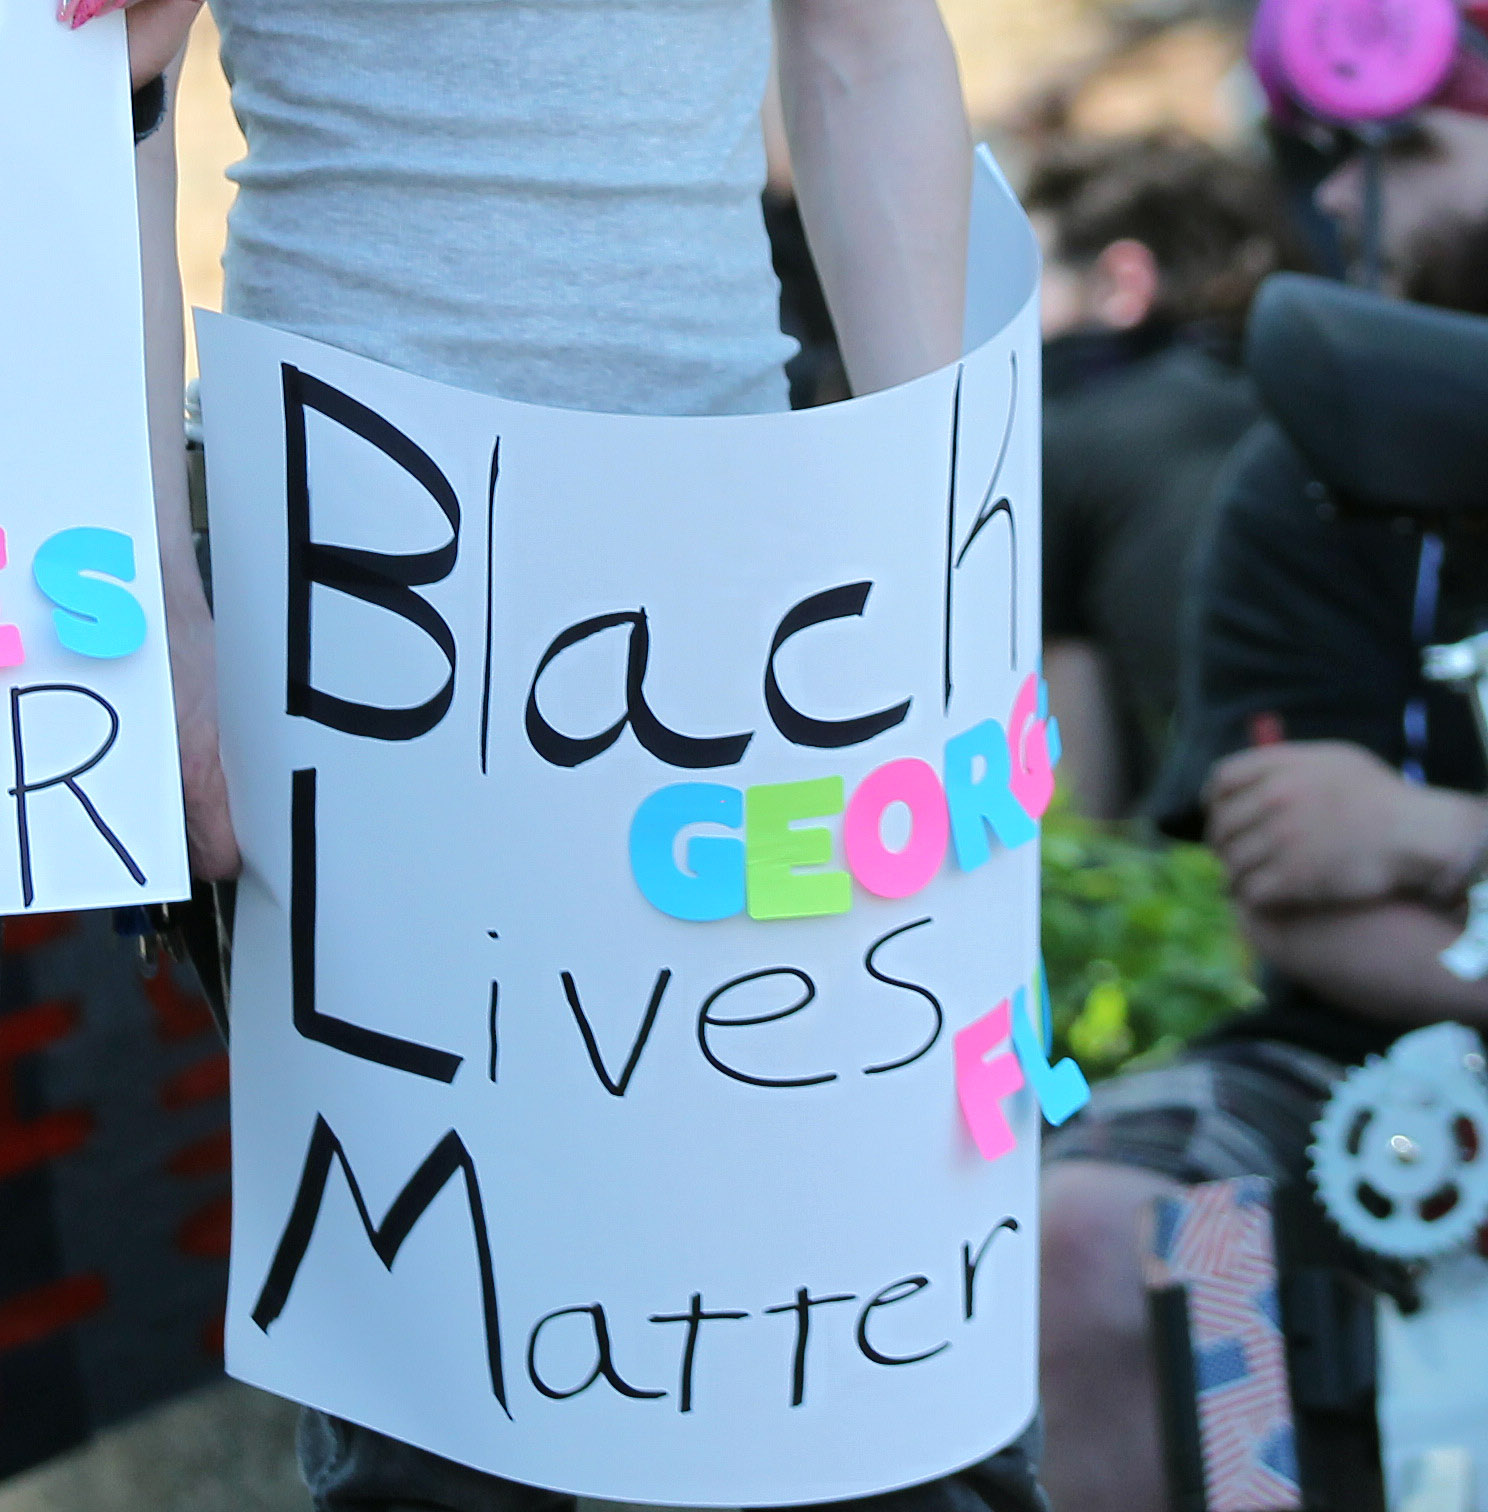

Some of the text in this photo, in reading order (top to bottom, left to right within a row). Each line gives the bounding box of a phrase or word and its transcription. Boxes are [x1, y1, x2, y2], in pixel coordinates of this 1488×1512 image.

[281, 350, 1019, 775] Black
[292, 767, 944, 1097] Lives
[628, 670, 1061, 922] GEORG
[252, 1112, 1019, 1420] Matter
